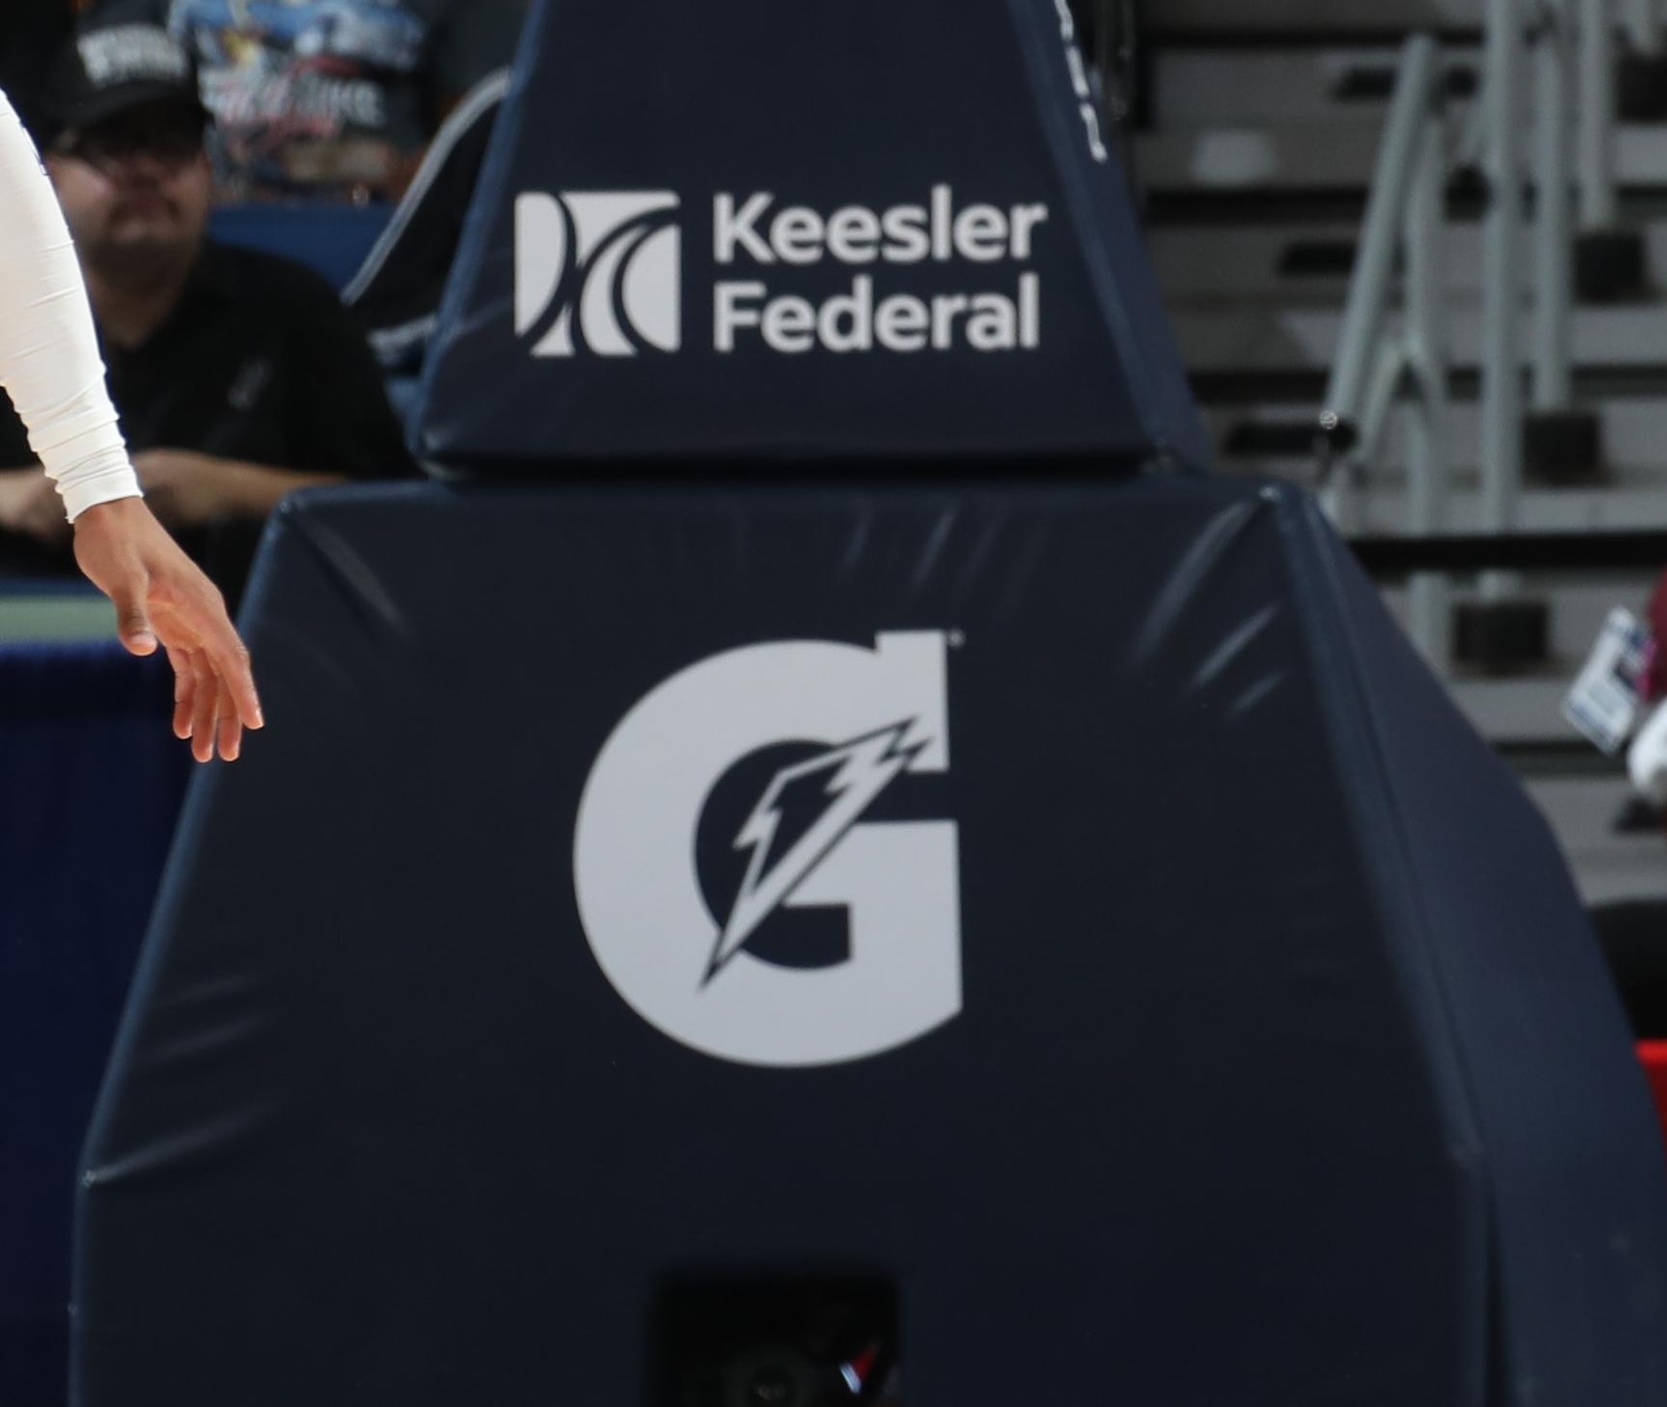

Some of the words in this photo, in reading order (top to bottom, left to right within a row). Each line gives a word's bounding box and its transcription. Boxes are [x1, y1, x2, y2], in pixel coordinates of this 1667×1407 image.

[712, 184, 1048, 264] Keesler
[712, 273, 1039, 353] Federal
[573, 629, 963, 1069] G
